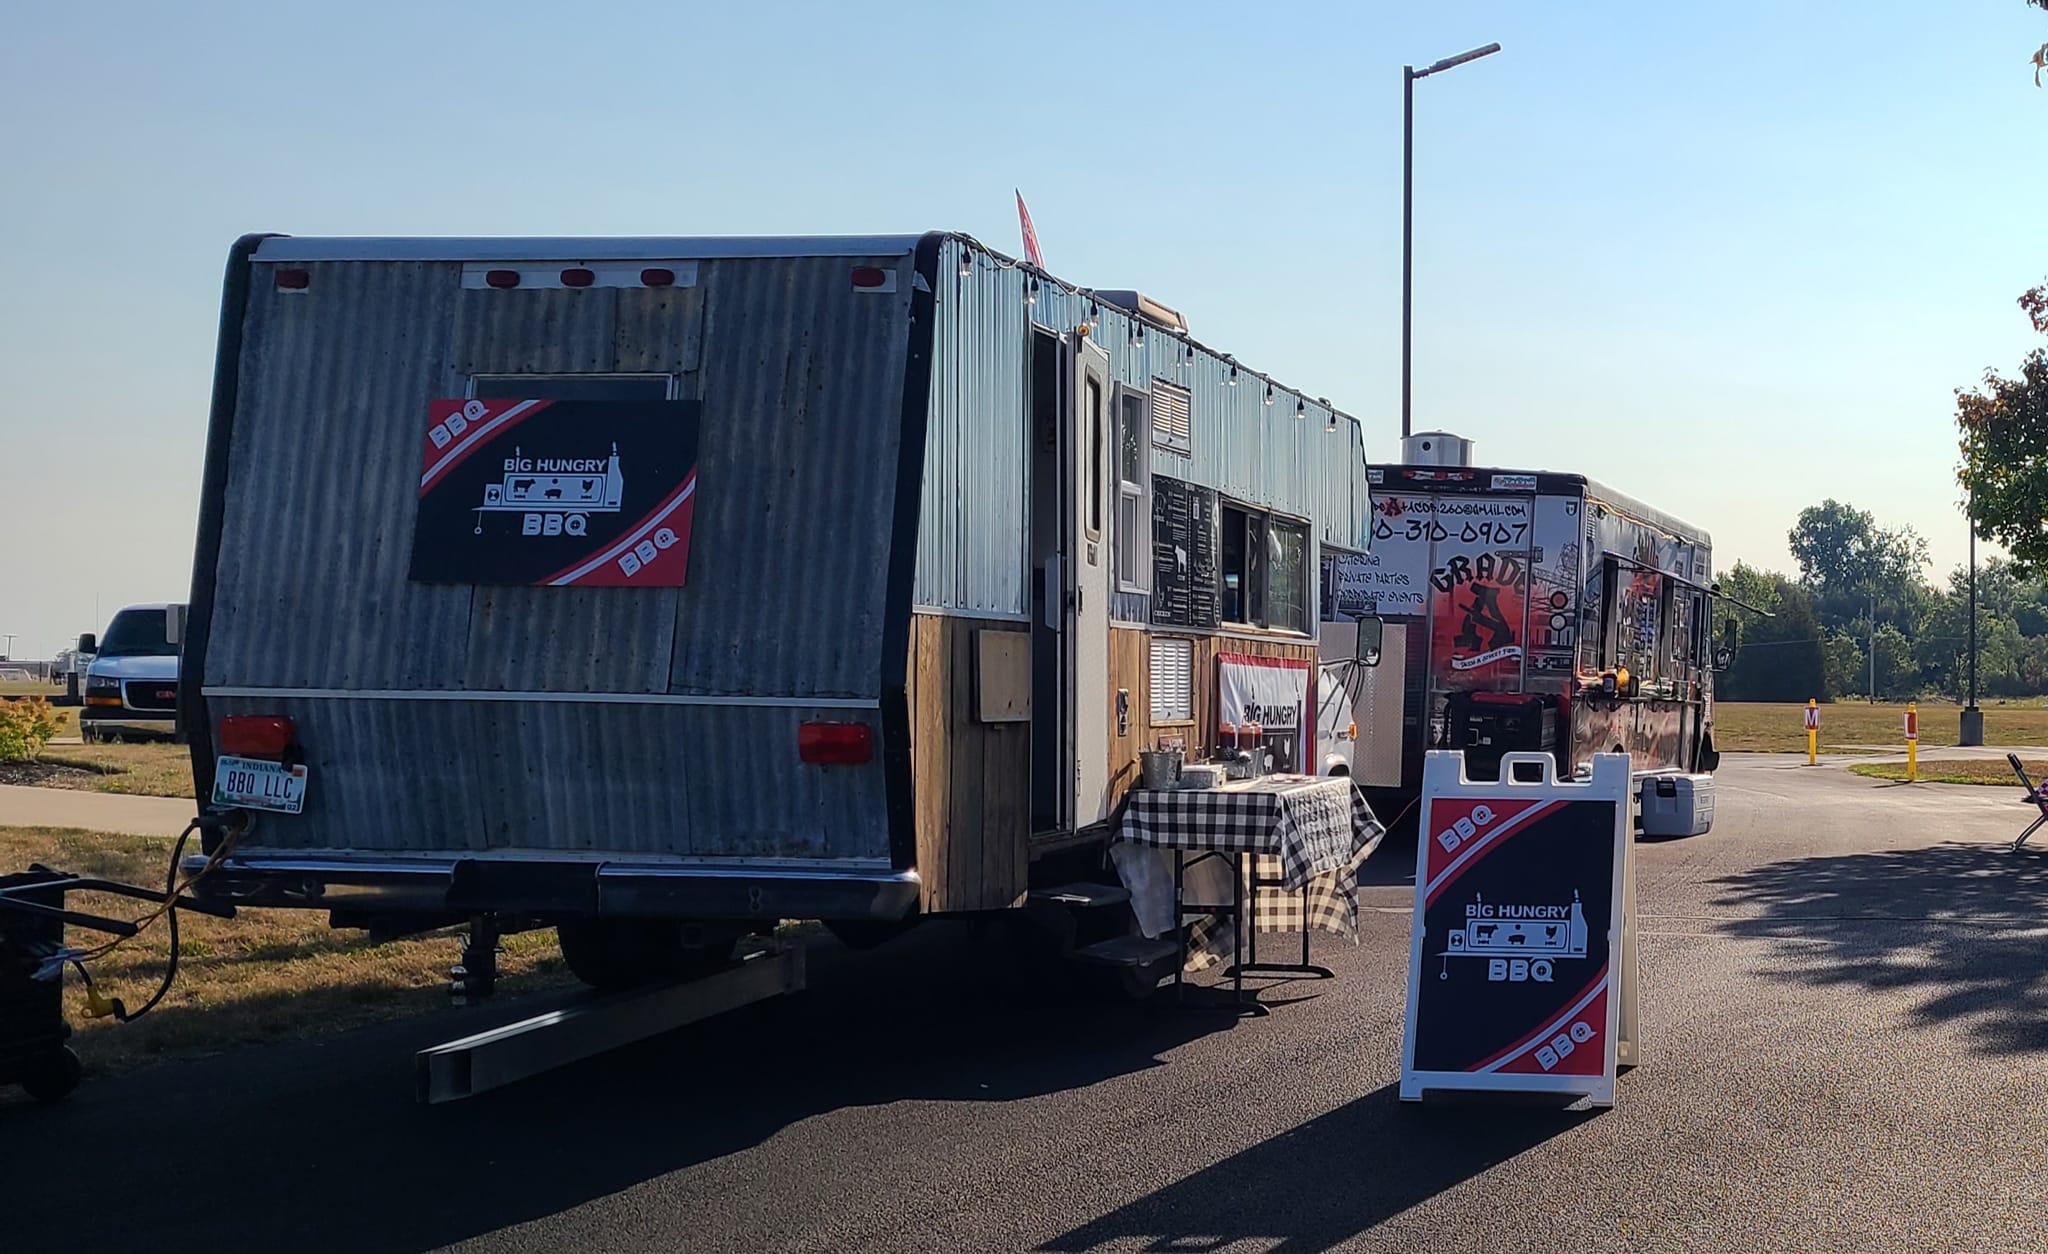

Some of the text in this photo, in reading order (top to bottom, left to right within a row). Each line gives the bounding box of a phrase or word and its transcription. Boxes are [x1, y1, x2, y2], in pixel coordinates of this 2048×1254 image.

[428, 400, 490, 449] BBQ
[504, 457, 607, 473] BIG HUNGRY
[522, 513, 588, 537] BBQ
[1373, 519, 1528, 545] 0-310-0907
[617, 527, 681, 578] BBQ
[156, 690, 176, 699] GM
[1243, 702, 1297, 725] BIG HUNGRY
[1805, 708, 1819, 727] M
[1904, 713, 1917, 738] L
[242, 761, 282, 774] INDIANA
[226, 770, 294, 799] BBQ LLC
[1436, 805, 1497, 853] BBQ
[1465, 903, 1570, 919] BIG HUNGRY
[1488, 958, 1554, 982] BBQ
[1534, 1021, 1597, 1072] BBQ
